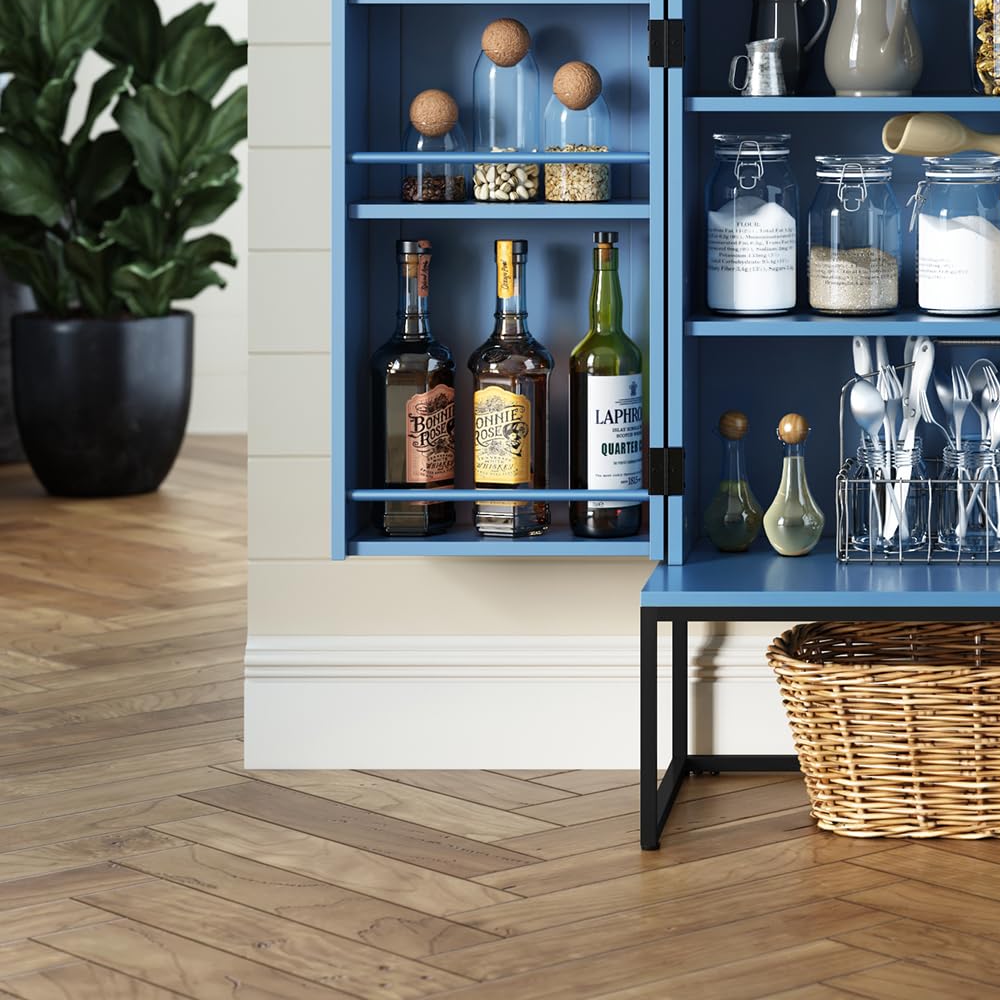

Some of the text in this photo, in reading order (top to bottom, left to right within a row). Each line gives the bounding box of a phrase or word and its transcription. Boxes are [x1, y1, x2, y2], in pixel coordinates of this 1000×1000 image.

[475, 408, 520, 429] ONNIE
[420, 423, 447, 447] ROSE
[601, 441, 638, 457] QUARTER
